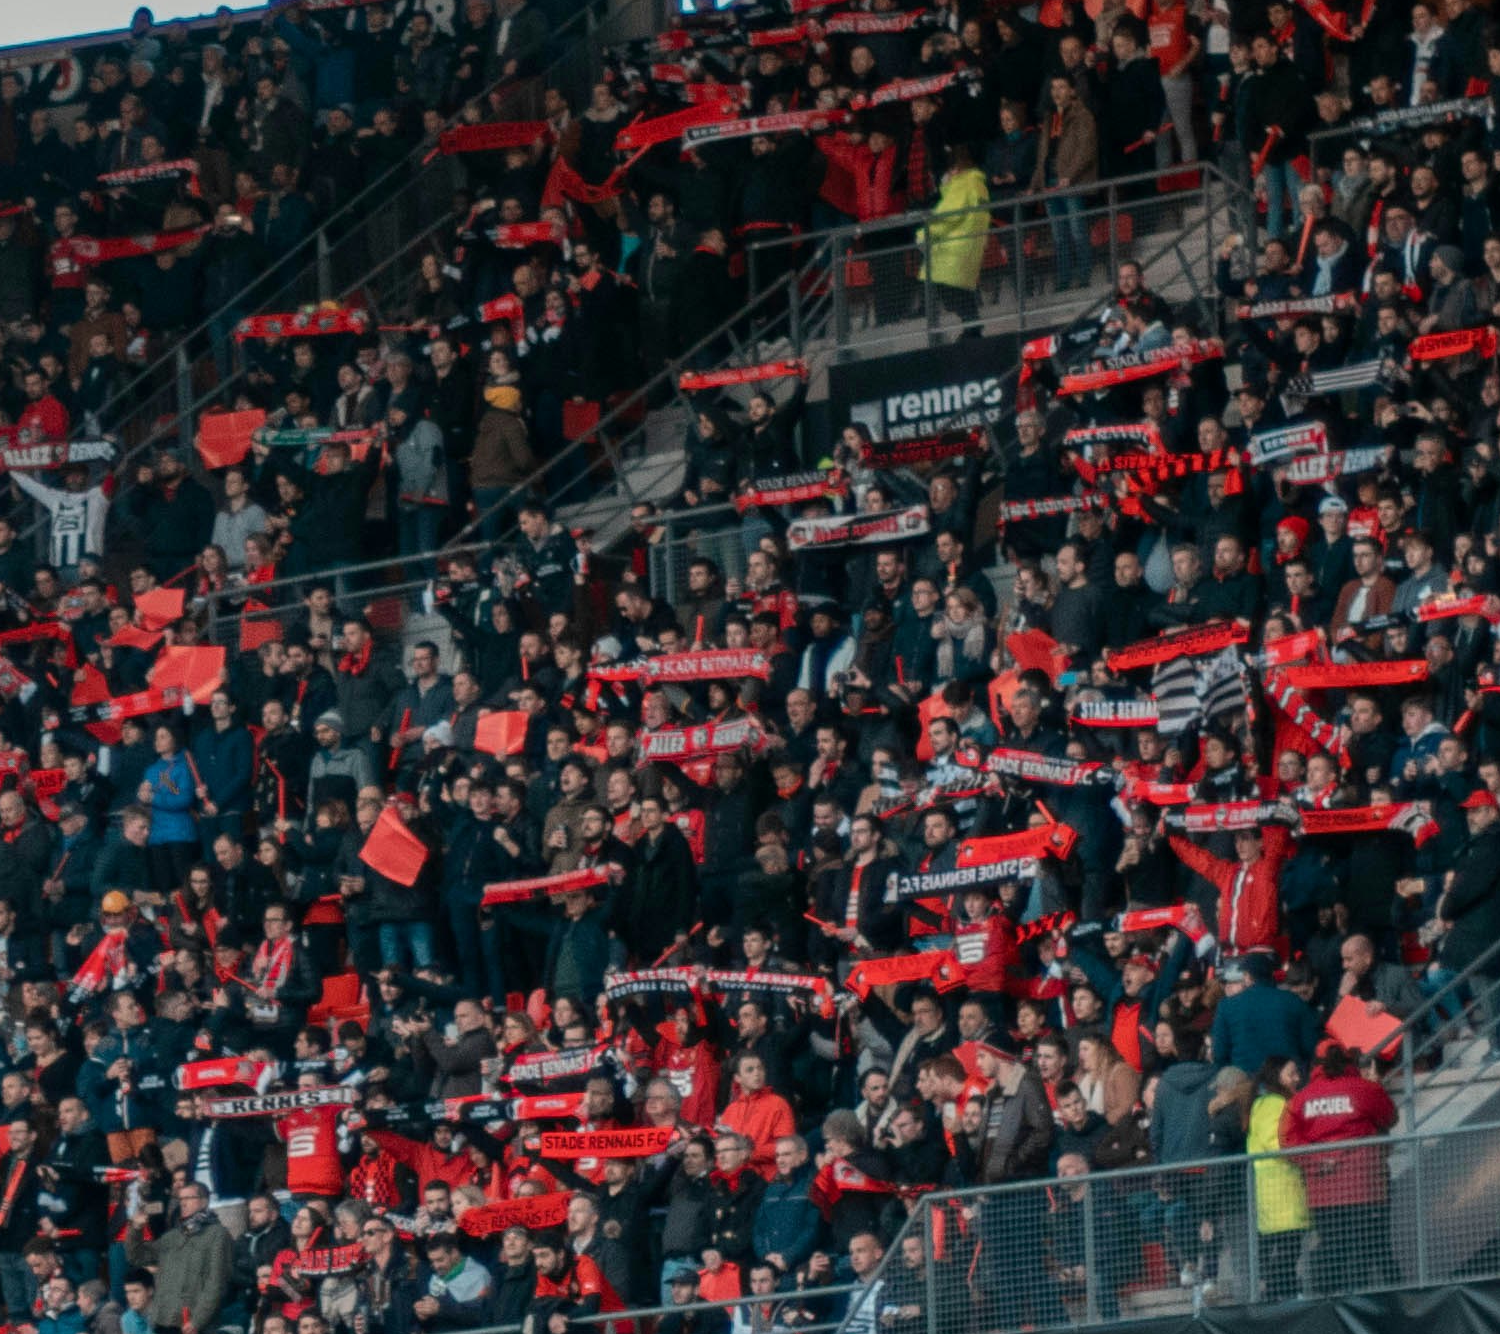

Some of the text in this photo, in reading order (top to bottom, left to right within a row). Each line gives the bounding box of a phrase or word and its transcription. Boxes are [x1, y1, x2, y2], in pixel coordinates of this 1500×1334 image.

[886, 377, 1004, 423] rennes
[1081, 701, 1113, 720] STADE
[986, 752, 1075, 784] STADE RENNAIS
[509, 1058, 541, 1081] STADE
[231, 1091, 321, 1114] RENNES
[1303, 1093, 1356, 1121] ACCUEIL
[544, 1133, 645, 1156] STADE RENNAIS
